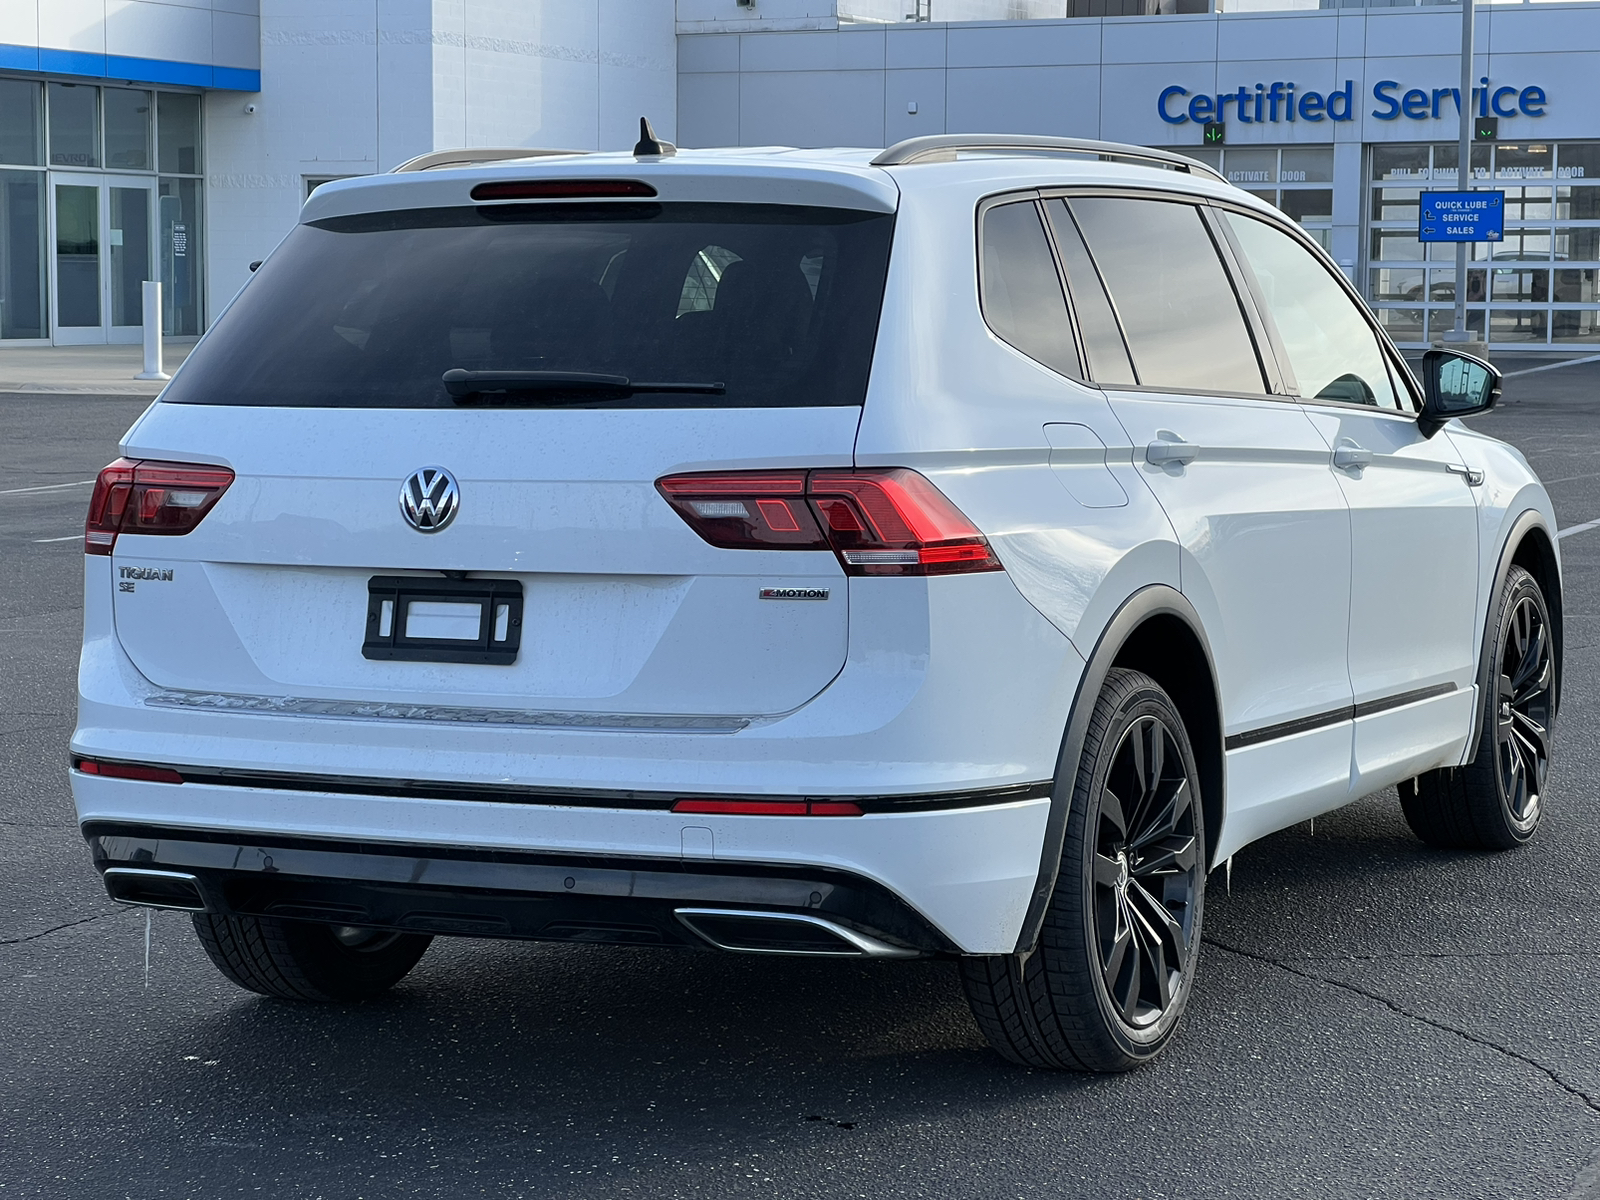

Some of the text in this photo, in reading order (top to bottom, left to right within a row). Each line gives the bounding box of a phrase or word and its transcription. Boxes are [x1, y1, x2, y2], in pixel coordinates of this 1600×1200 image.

[1157, 77, 1548, 124] Certified Service
[1228, 171, 1306, 181] ACTIVATE DOOR
[1474, 167, 1487, 178] TO
[1500, 167, 1545, 178] ACTIVATE
[1558, 167, 1585, 178] DOOR
[1435, 201, 1487, 209] QUICK LUBE
[1442, 213, 1479, 222] SERVICE
[1446, 226, 1475, 235] SALES
[118, 566, 174, 582] TIGUAN
[118, 581, 136, 594] SE
